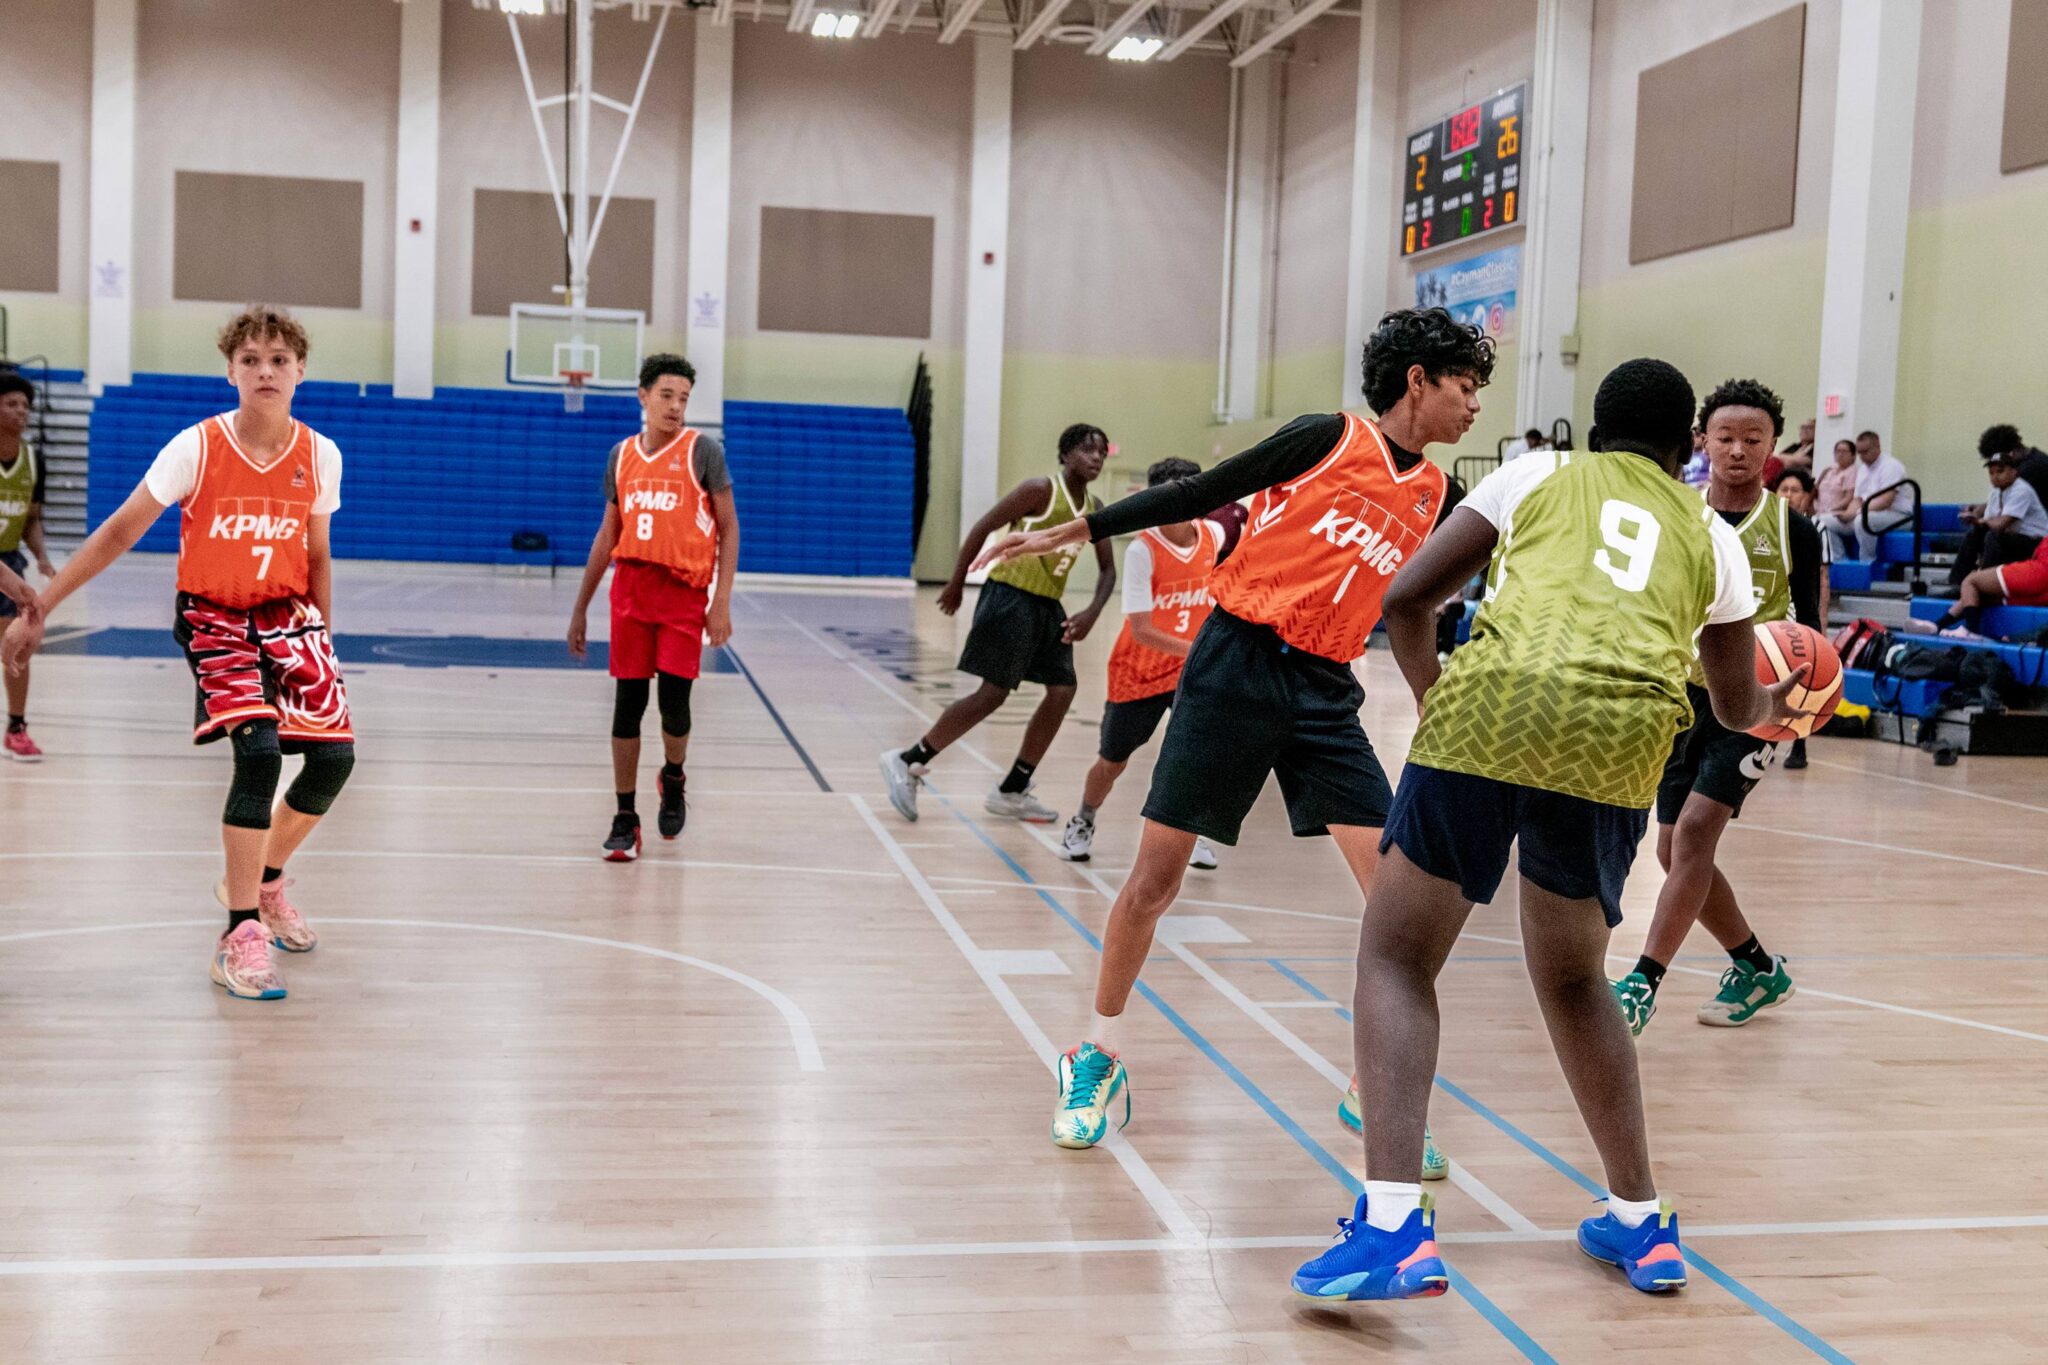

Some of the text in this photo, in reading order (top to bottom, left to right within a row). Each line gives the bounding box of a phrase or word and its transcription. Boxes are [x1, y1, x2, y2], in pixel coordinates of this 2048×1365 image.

[1496, 115, 1518, 159] 26
[1415, 153, 1427, 192] 2
[1462, 151, 1473, 182] 2
[1483, 198, 1494, 230] 2
[1503, 191, 1515, 223] 0
[1405, 225, 1416, 254] 0
[1421, 219, 1432, 249] 2
[624, 490, 678, 514] KPMG
[209, 514, 299, 540] KPMG
[636, 512, 654, 541] 8
[1309, 508, 1403, 576] KPMG
[1593, 499, 1661, 592] 9
[251, 545, 273, 580] 7
[1053, 557, 1070, 577] 2
[1332, 563, 1359, 605] 1
[1174, 609, 1191, 633] 3
